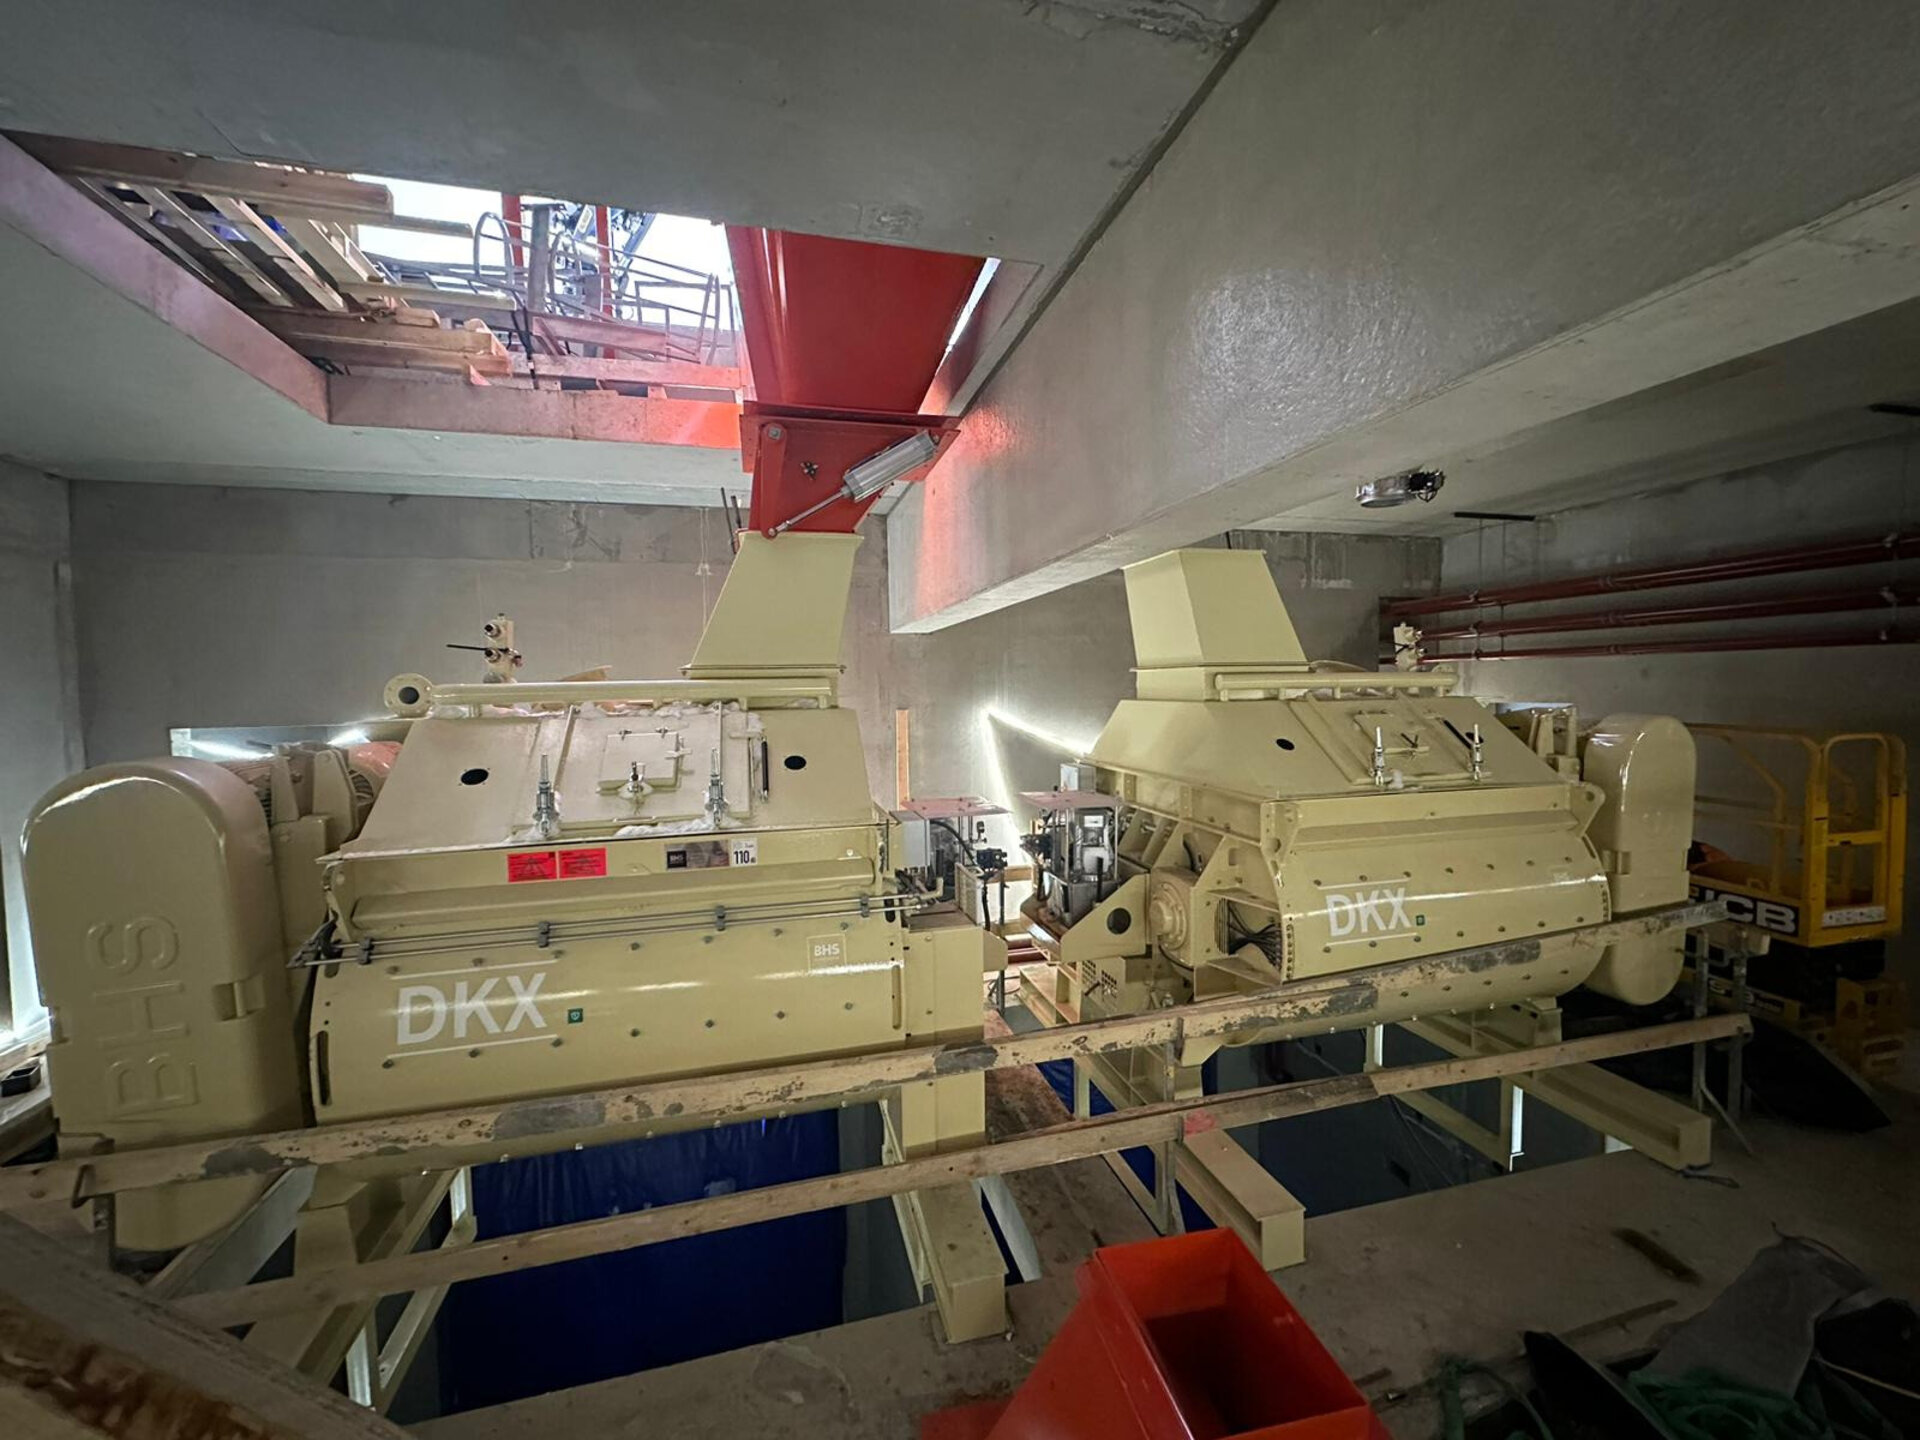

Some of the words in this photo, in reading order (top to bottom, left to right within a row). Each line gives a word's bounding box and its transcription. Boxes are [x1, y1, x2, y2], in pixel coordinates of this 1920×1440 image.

[734, 850, 750, 865] 110
[1325, 887, 1412, 937] DKX
[814, 943, 840, 957] BHS
[85, 916, 200, 1118] BHS
[396, 972, 548, 1046] DKX
